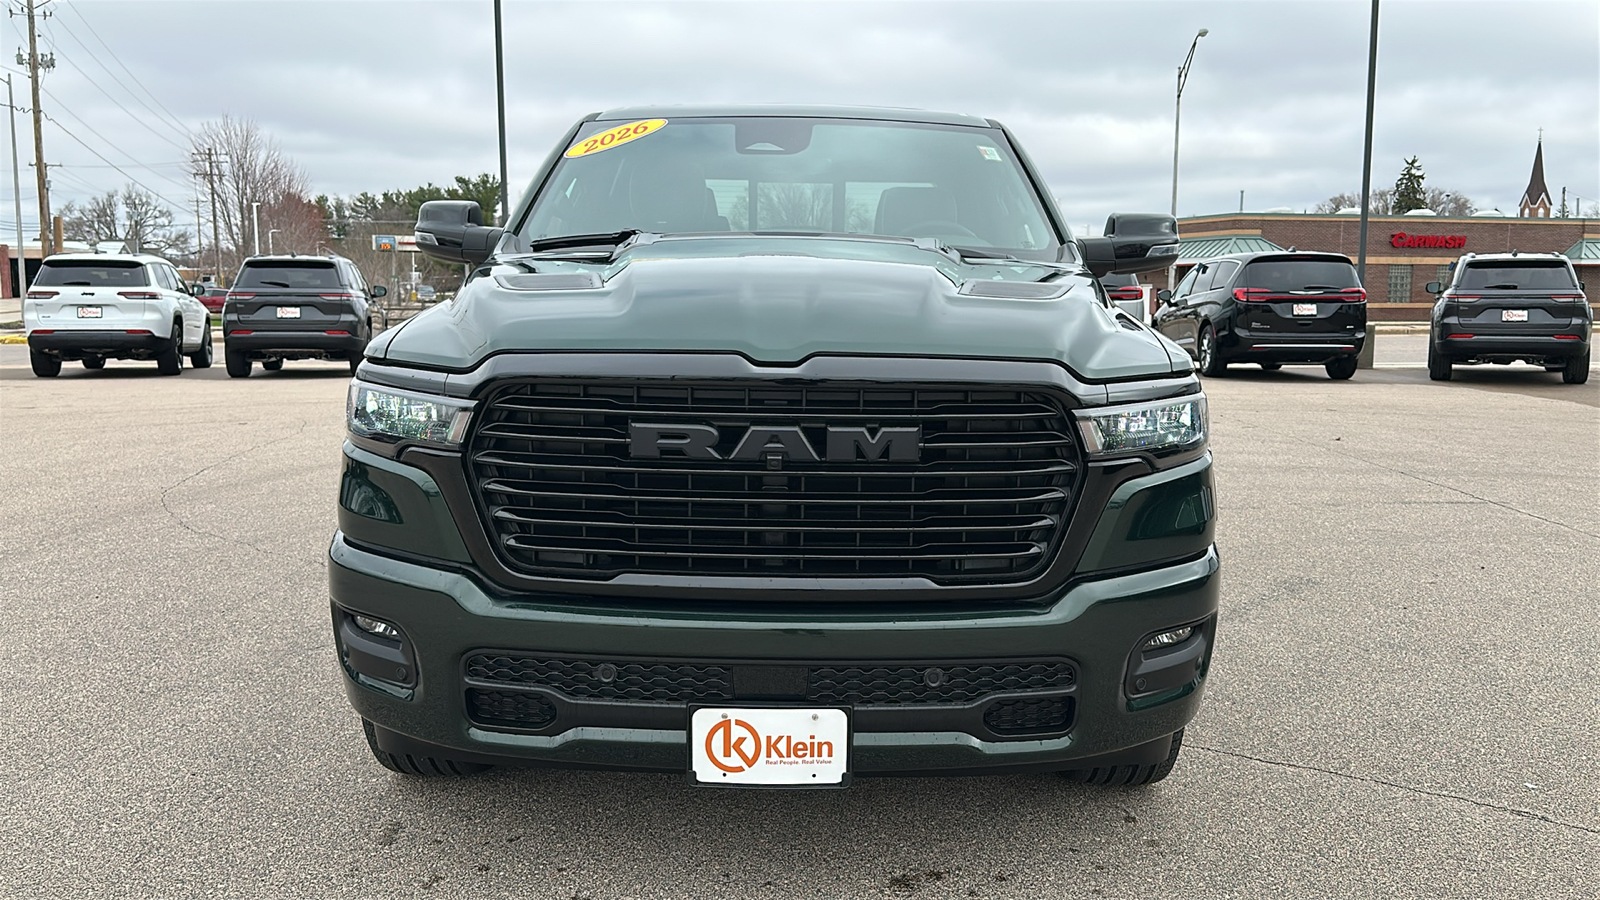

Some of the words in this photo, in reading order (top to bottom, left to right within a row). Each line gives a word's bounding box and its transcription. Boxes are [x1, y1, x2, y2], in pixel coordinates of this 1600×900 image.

[584, 121, 648, 153] 2026
[1391, 232, 1467, 248] CARWASH
[630, 422, 921, 461] RAM
[766, 735, 833, 758] Klein
